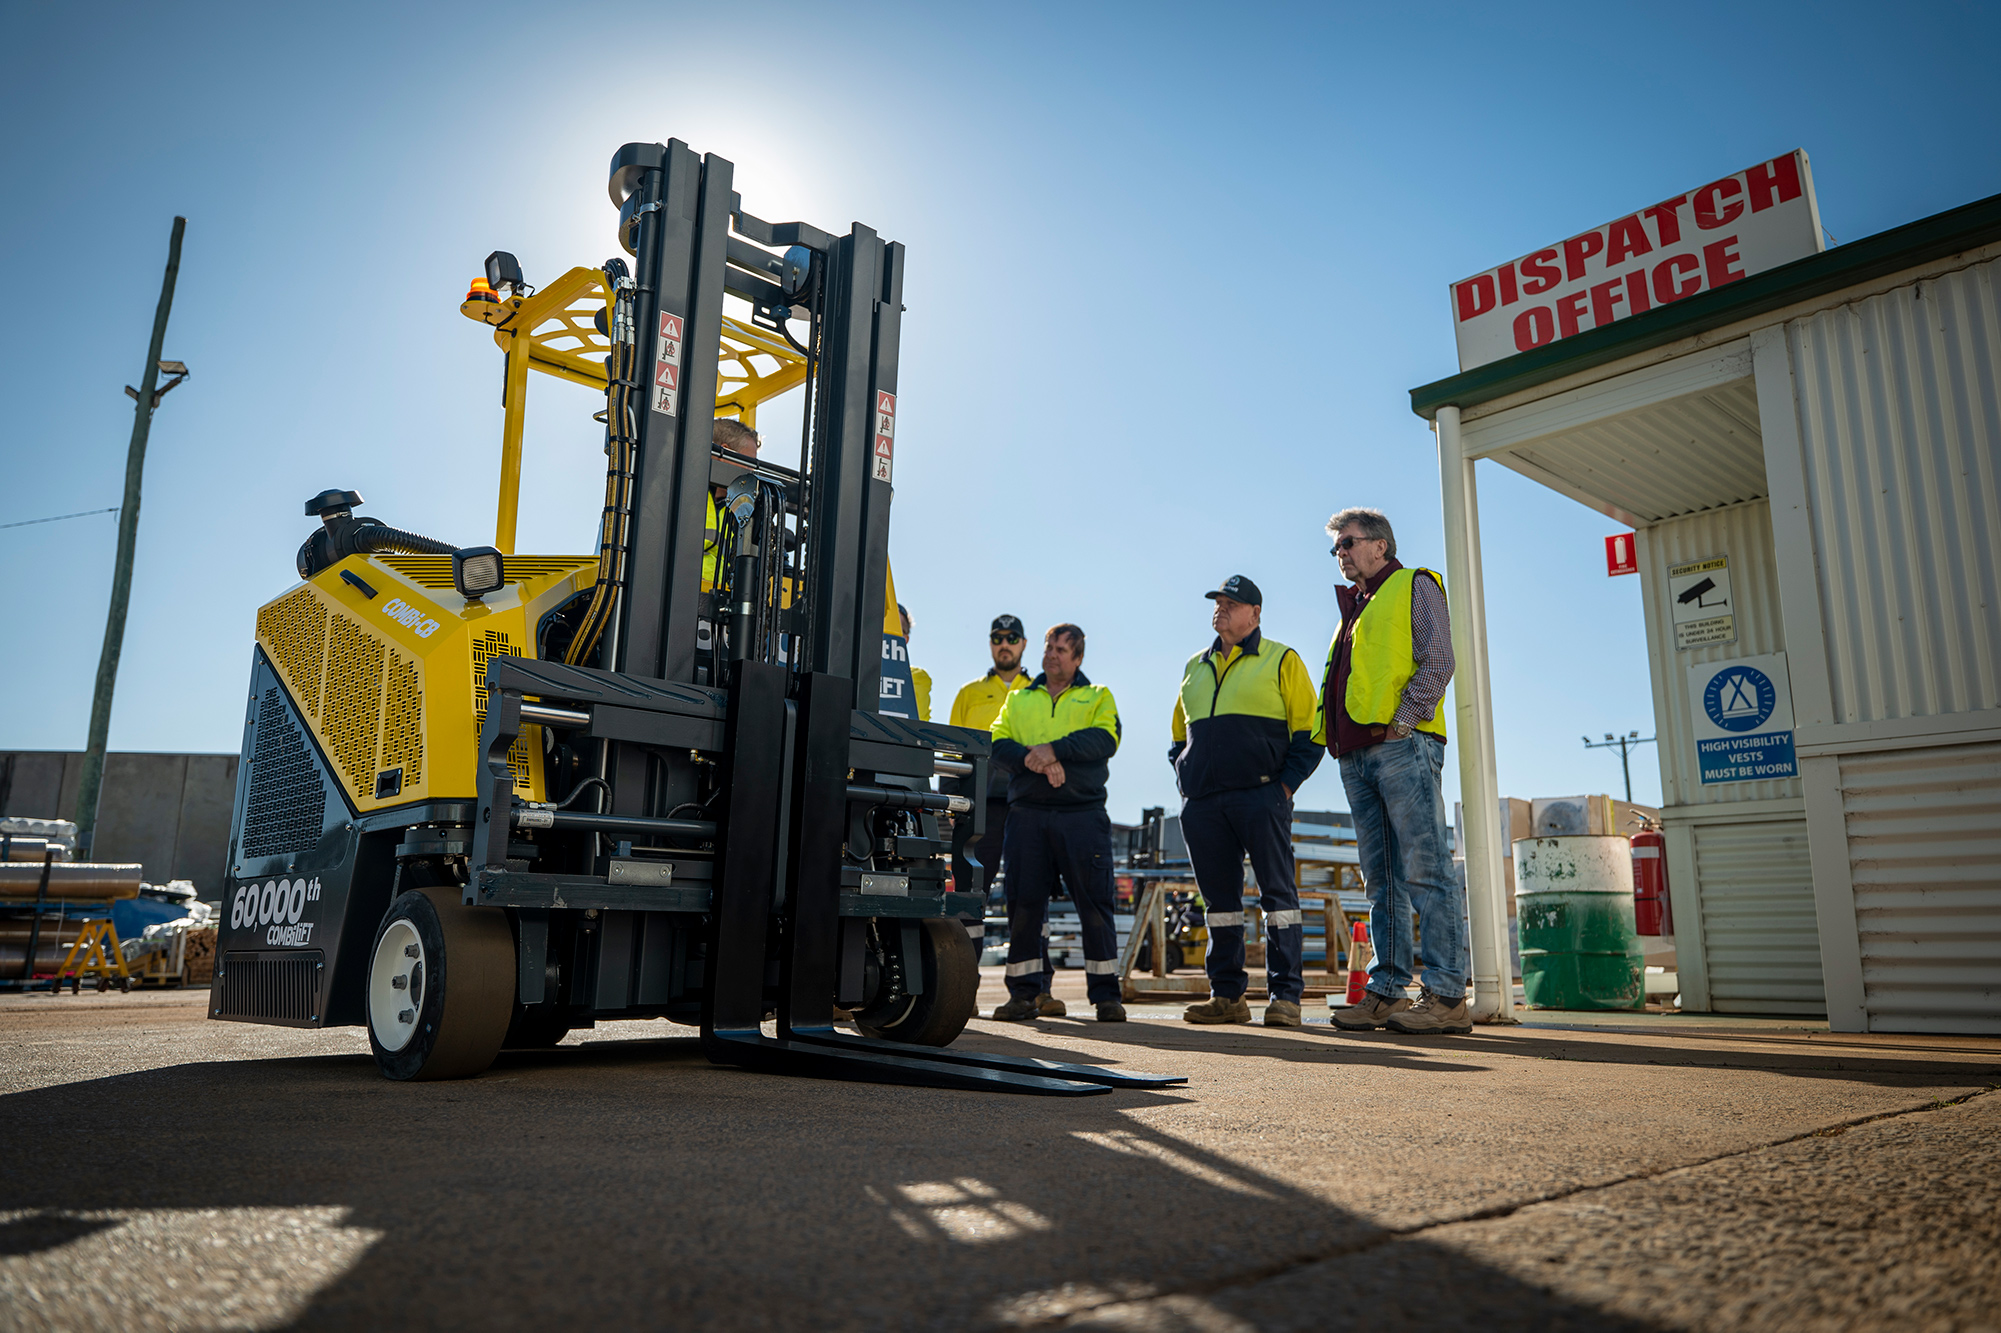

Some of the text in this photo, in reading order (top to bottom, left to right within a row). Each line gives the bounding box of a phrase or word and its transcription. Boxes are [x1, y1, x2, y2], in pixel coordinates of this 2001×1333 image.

[1456, 152, 1802, 323] DISPATCH
[1513, 234, 1746, 353] OFFICE
[1672, 560, 1724, 576] SECURITY NOTICE
[1699, 619, 1724, 628] BUILDING
[1685, 633, 1726, 644] SURVEILLANCE
[1686, 629, 1705, 637] UNDER
[1701, 734, 1789, 752] HIGH VISIBILITY
[1728, 751, 1763, 763] VESTS
[1705, 762, 1792, 780] MUST BE WORN
